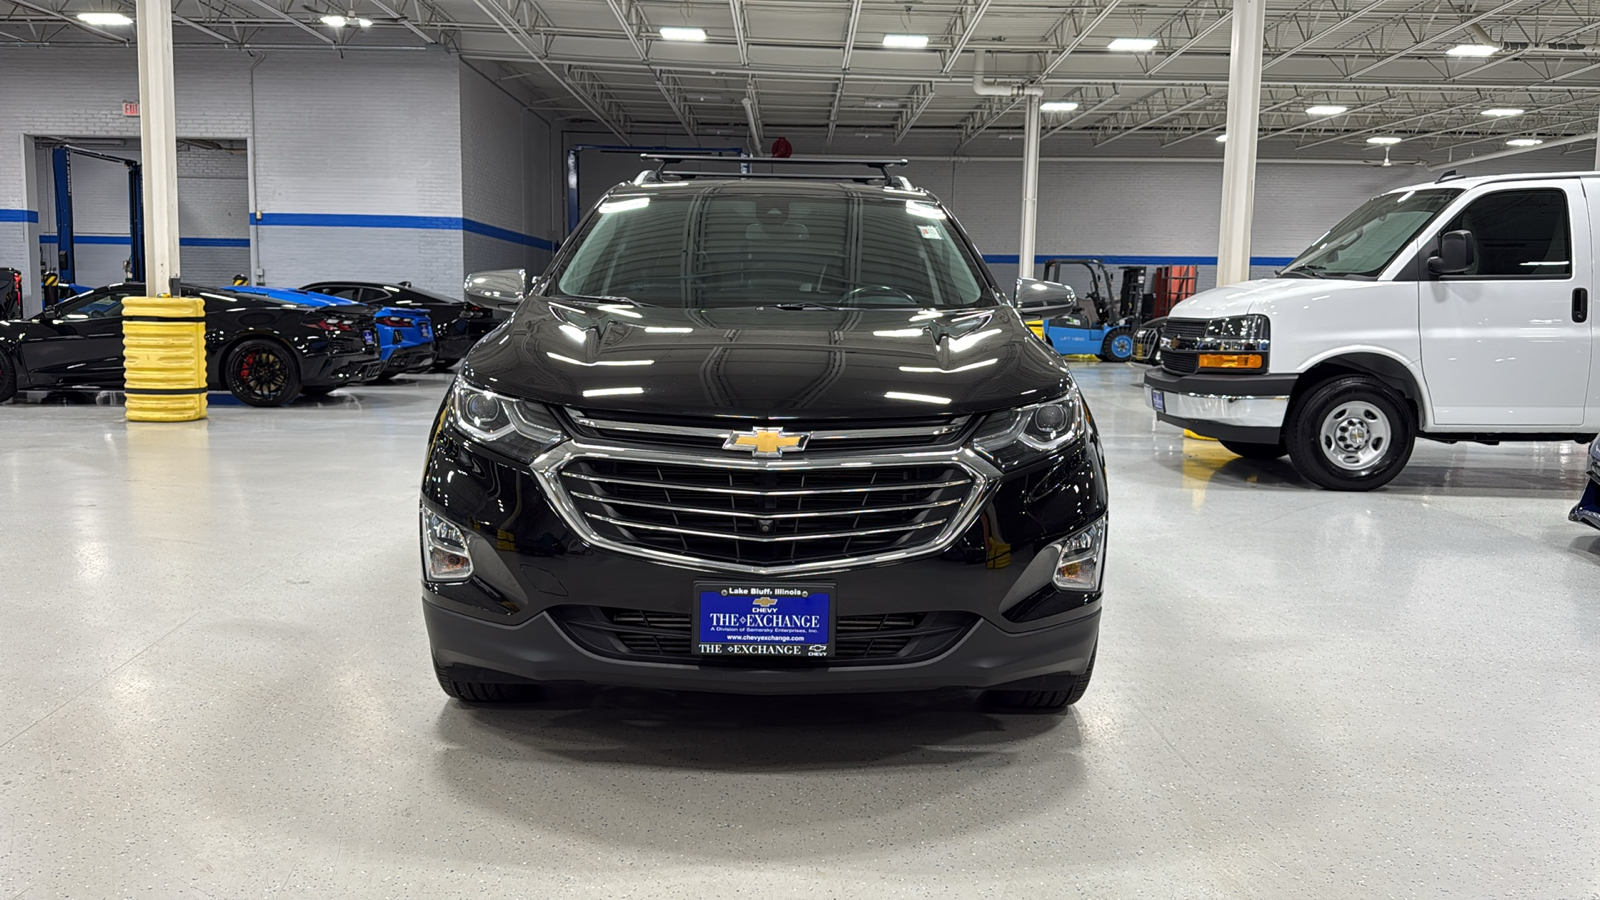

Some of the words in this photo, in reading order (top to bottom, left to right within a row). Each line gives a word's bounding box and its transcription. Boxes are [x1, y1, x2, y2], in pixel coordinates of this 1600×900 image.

[125, 103, 138, 115] EXIT
[728, 587, 749, 595] Lake
[750, 587, 773, 596] Bluff,
[774, 588, 802, 596] Illinois
[709, 613, 740, 626] THE
[746, 614, 820, 628] EXCHANGE
[726, 634, 805, 643] www.chevyexchange.com
[698, 644, 723, 654] THE
[733, 644, 802, 655] EXCHANGE
